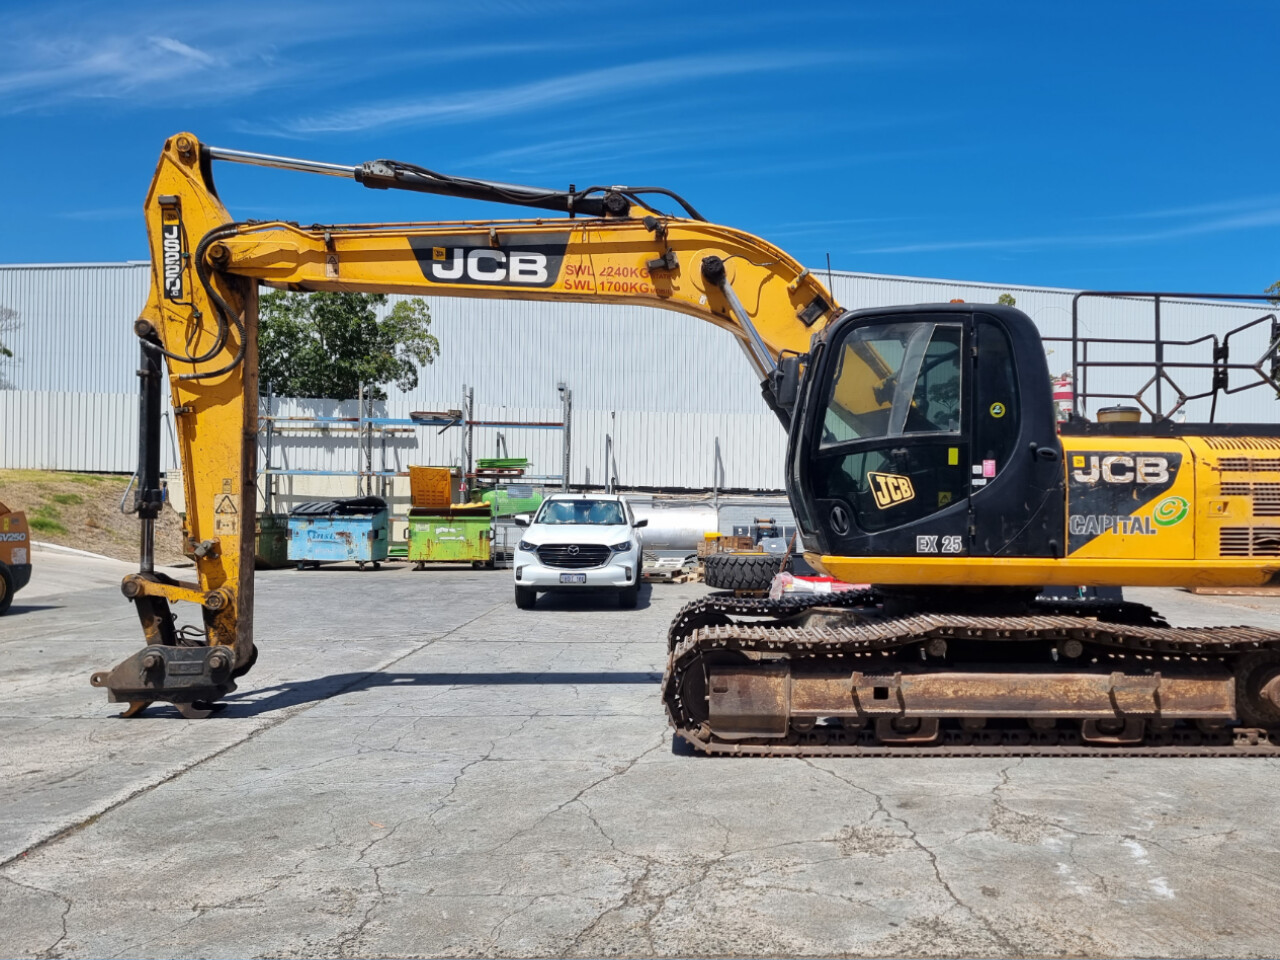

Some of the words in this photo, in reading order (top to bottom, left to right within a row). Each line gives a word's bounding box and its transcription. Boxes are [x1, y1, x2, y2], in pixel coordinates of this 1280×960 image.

[432, 247, 549, 284] JCB
[565, 264, 594, 277] SWL
[564, 279, 594, 291] SWL
[599, 281, 649, 294] 1700KG
[1073, 456, 1170, 483] JCB
[875, 475, 912, 505] JCB
[1069, 515, 1158, 535] CAPITAL
[916, 535, 939, 553] EX
[941, 535, 962, 553] 25
